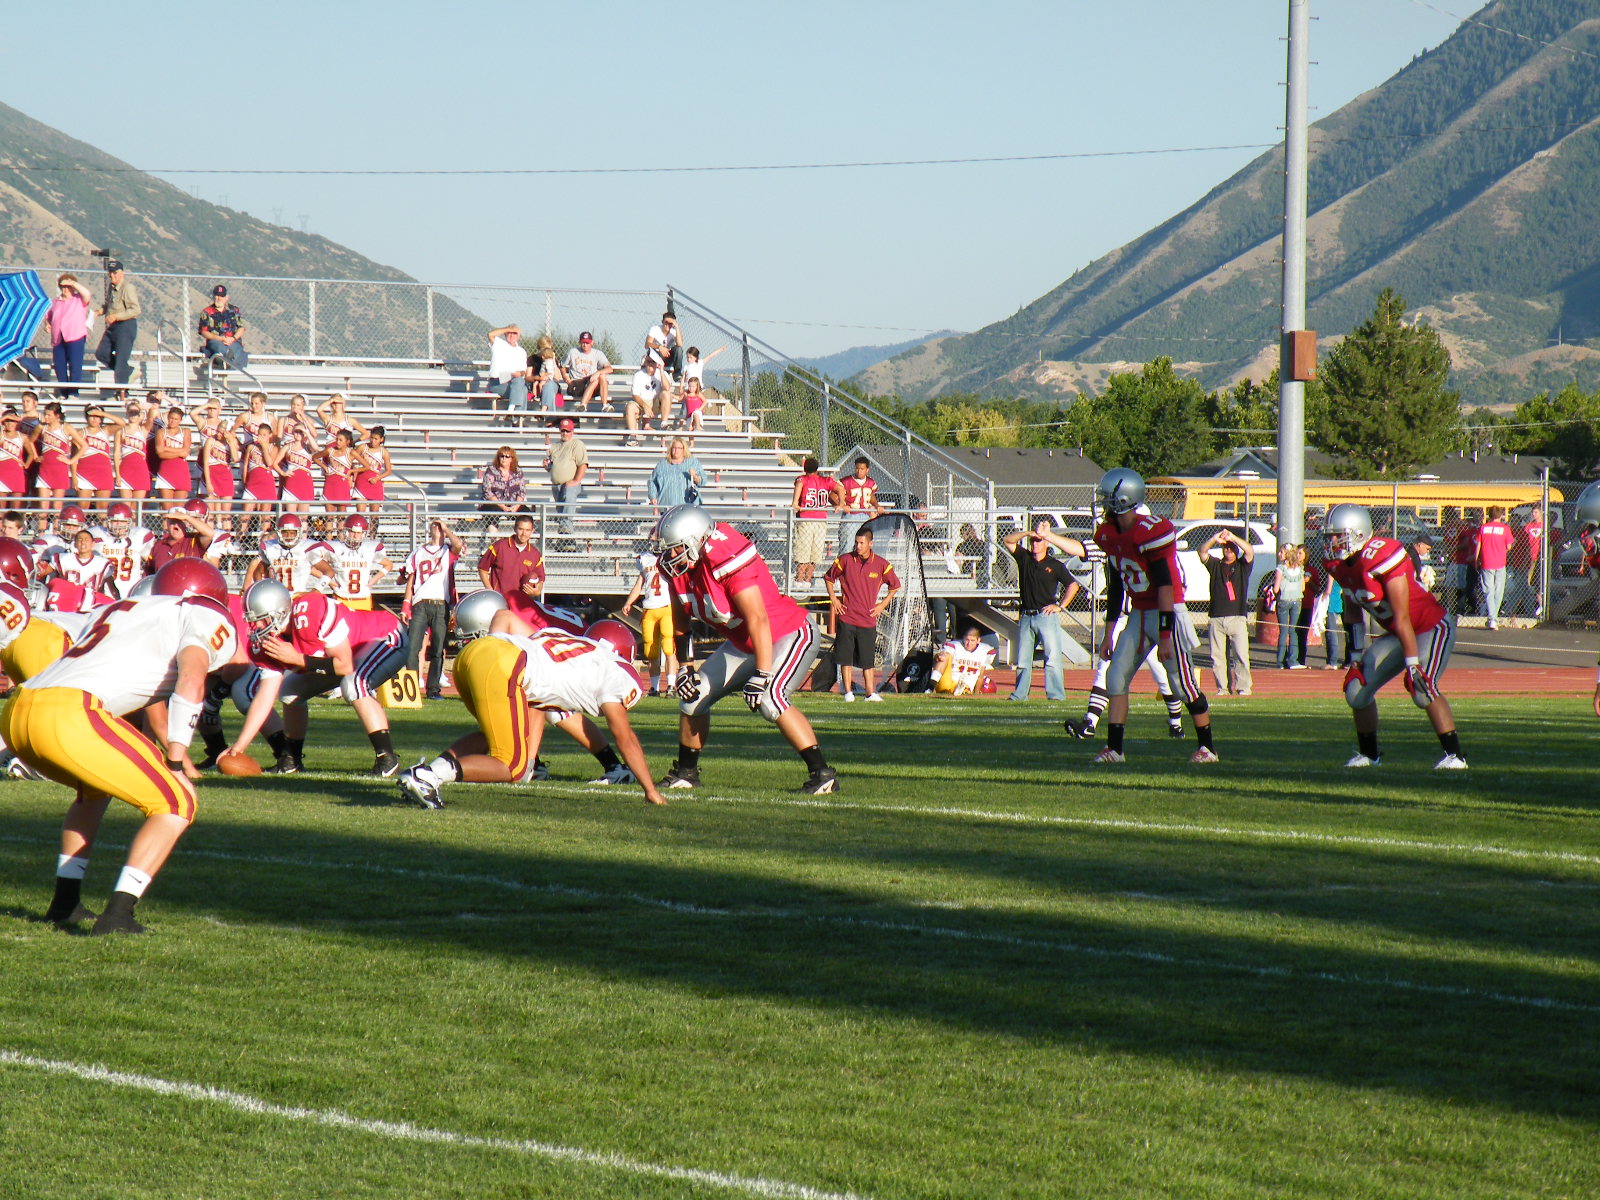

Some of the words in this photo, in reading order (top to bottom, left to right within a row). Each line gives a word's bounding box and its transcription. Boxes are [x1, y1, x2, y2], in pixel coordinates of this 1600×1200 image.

[805, 488, 829, 508] 50
[1139, 515, 1163, 531] 10
[1362, 539, 1386, 559] 26
[276, 567, 294, 591] 11
[349, 569, 361, 594] 8
[651, 573, 661, 596] 4
[0, 600, 23, 630] 28
[210, 624, 230, 651] 5
[391, 673, 417, 702] 50
